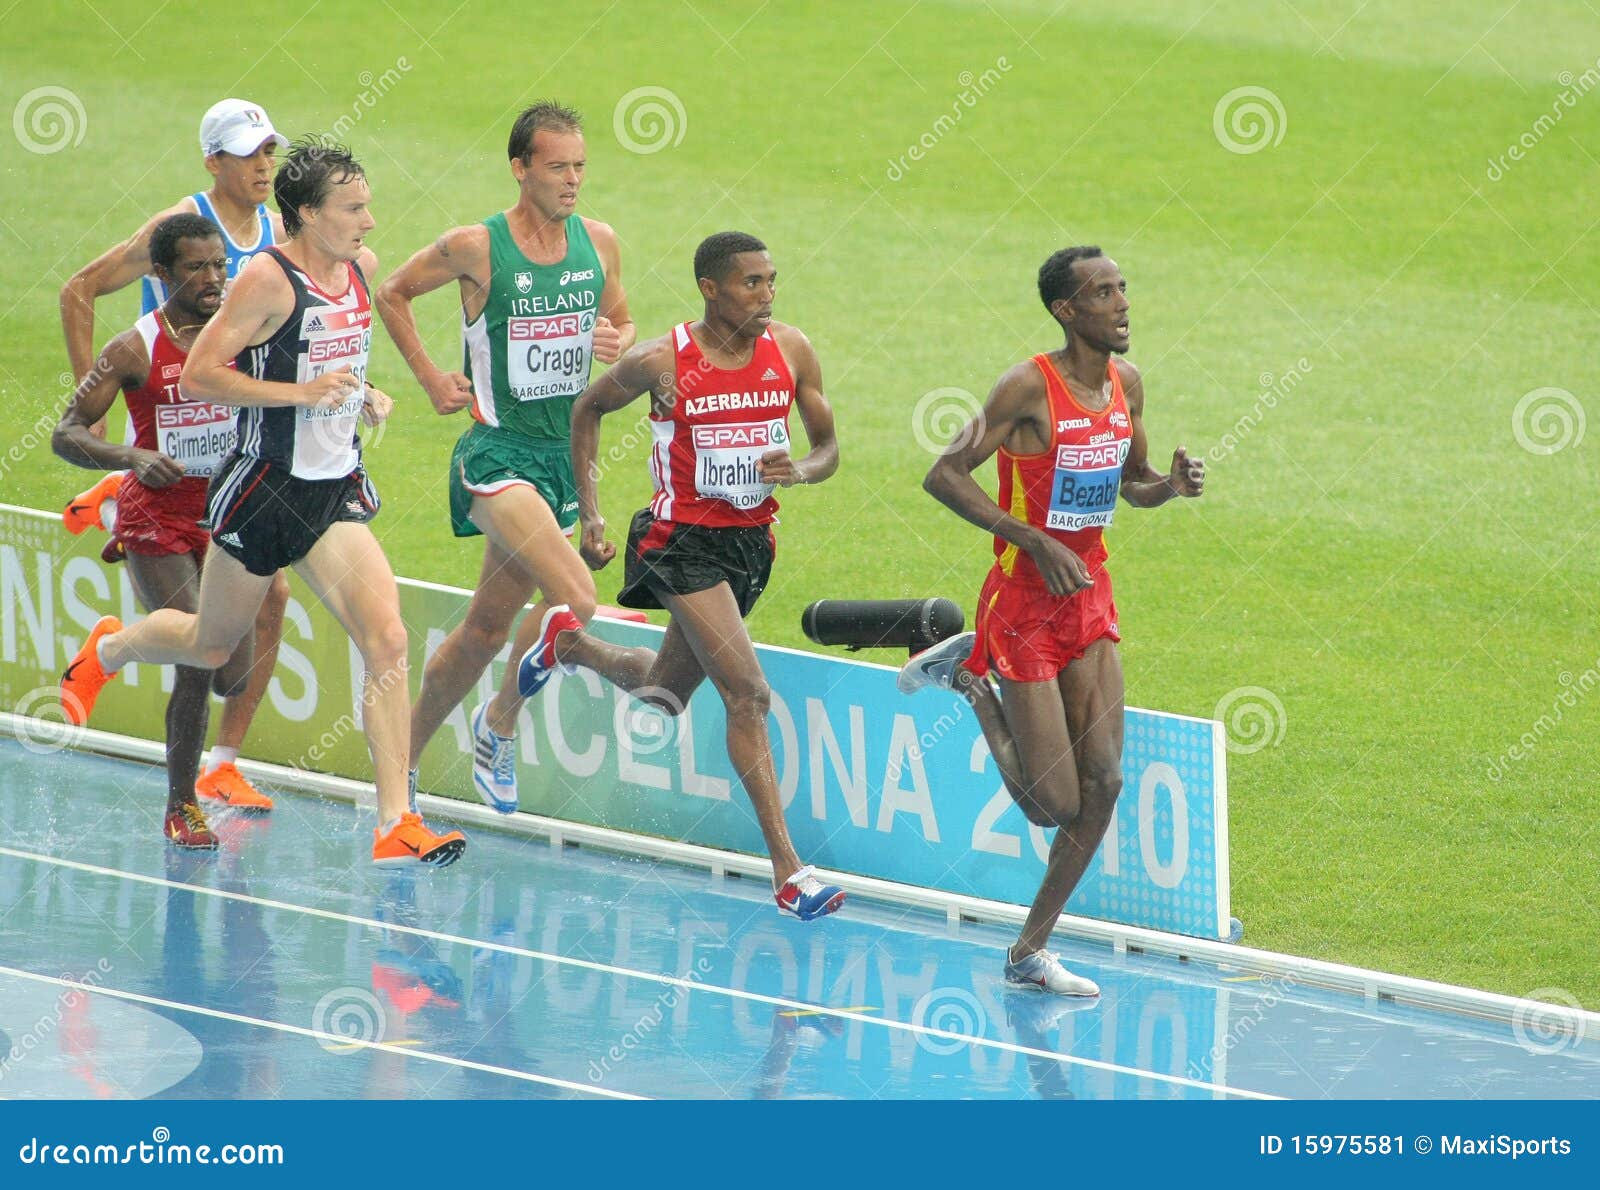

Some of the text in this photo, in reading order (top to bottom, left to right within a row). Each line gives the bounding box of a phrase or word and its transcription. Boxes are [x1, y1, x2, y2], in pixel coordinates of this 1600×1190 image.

[571, 269, 594, 282] asics
[511, 290, 595, 315] IRELAND
[510, 317, 577, 338] SPAR
[310, 337, 360, 359] SPAR
[526, 344, 584, 376] Cragg
[511, 382, 574, 398] BARCELONA
[685, 390, 790, 416] AZERBAIJAN
[159, 405, 229, 426] SPAR
[696, 427, 768, 447] SPAR
[1060, 446, 1117, 467] SPAR
[1050, 513, 1107, 528] BARCELONA
[348, 628, 940, 844] ARCELONA
[969, 734, 1190, 889] 20
